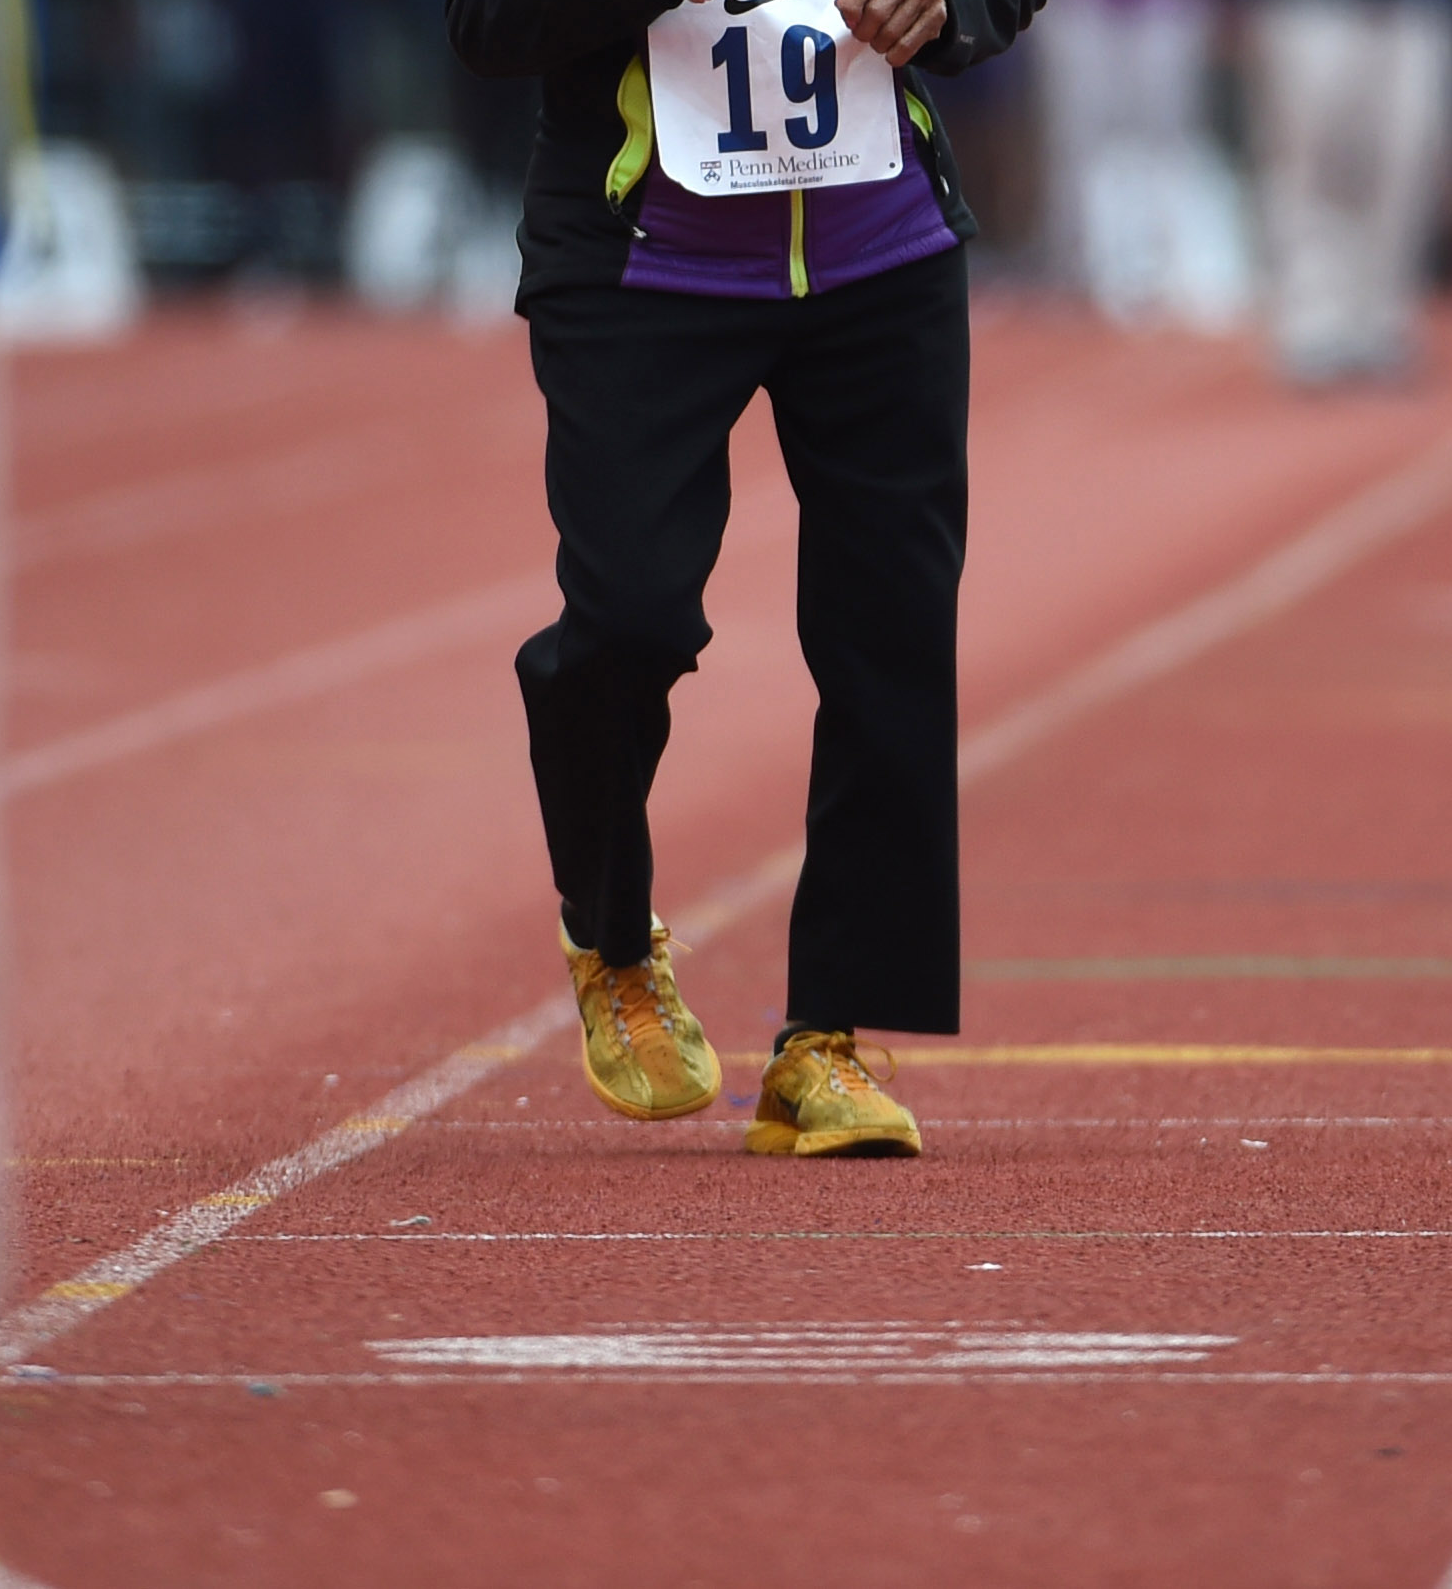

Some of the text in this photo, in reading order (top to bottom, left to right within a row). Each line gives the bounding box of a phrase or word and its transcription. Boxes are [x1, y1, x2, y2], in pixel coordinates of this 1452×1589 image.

[712, 25, 838, 153] 19
[730, 150, 860, 176] Penn Medicine
[799, 175, 824, 186] Center
